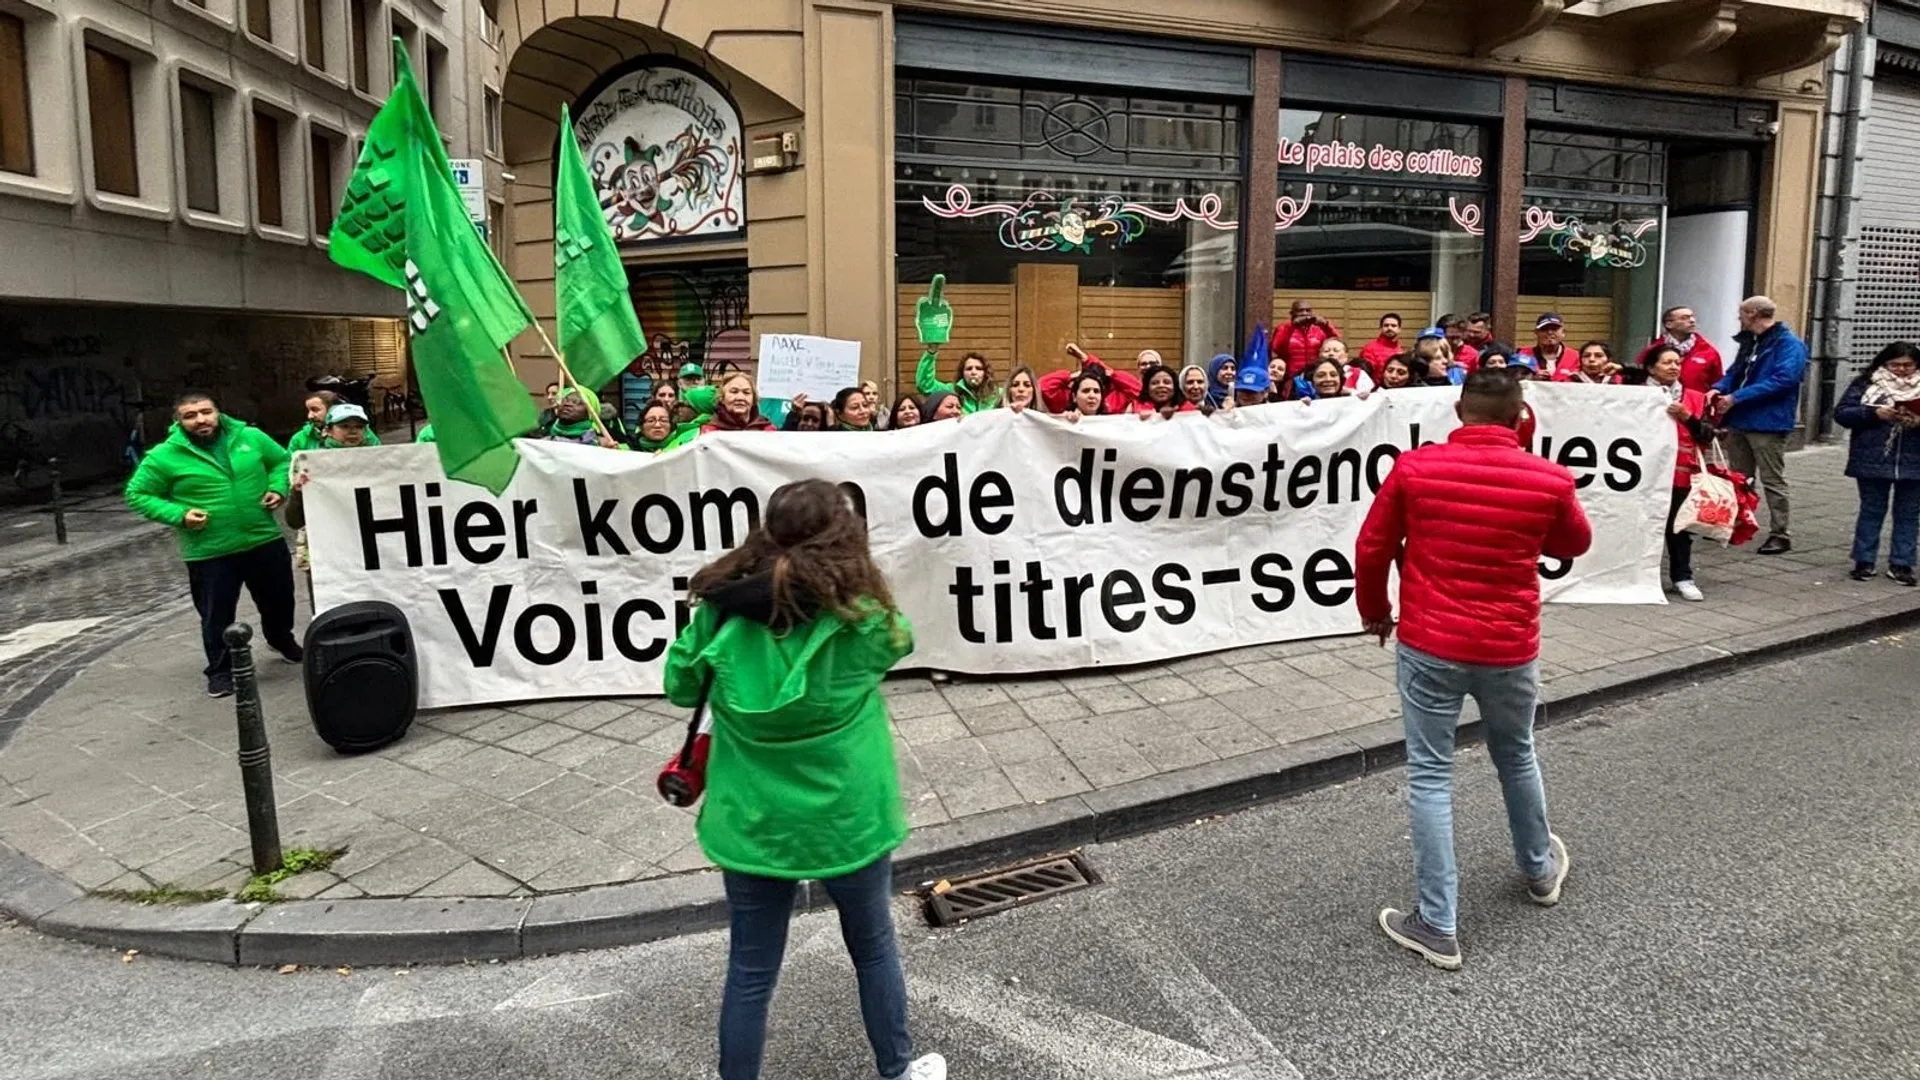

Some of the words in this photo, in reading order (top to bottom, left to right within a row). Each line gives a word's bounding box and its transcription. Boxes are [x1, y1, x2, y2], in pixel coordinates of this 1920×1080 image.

[1277, 136, 1304, 164] Le
[1307, 140, 1366, 173] palais
[1368, 144, 1404, 172] des
[1406, 149, 1483, 177] cotillons
[355, 482, 538, 570] Hier
[912, 452, 1015, 538] de
[438, 576, 692, 668] Voici
